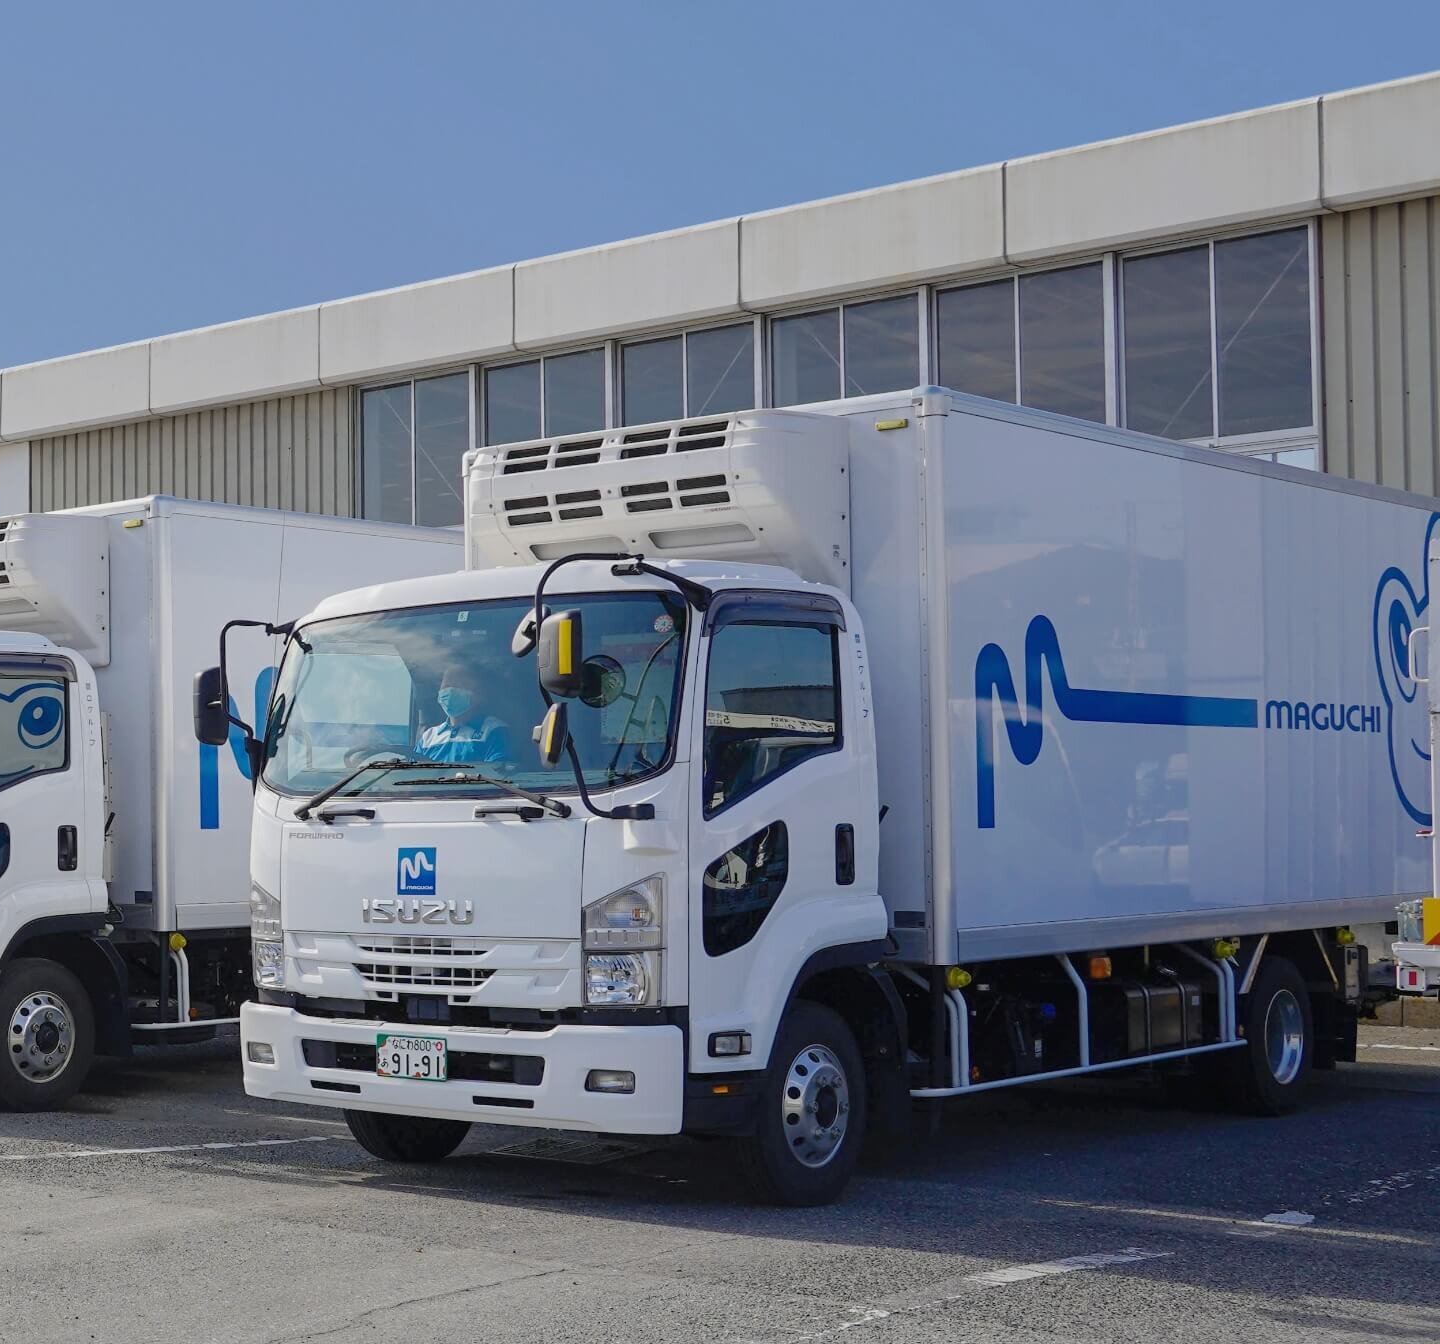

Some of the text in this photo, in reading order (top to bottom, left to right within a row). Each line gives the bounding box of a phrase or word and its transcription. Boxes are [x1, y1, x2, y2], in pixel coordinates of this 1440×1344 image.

[1265, 700, 1381, 733] MAGUCHI
[289, 832, 344, 840] FORWARD
[362, 898, 475, 925] ISUZU
[392, 1053, 440, 1078] 91-91
